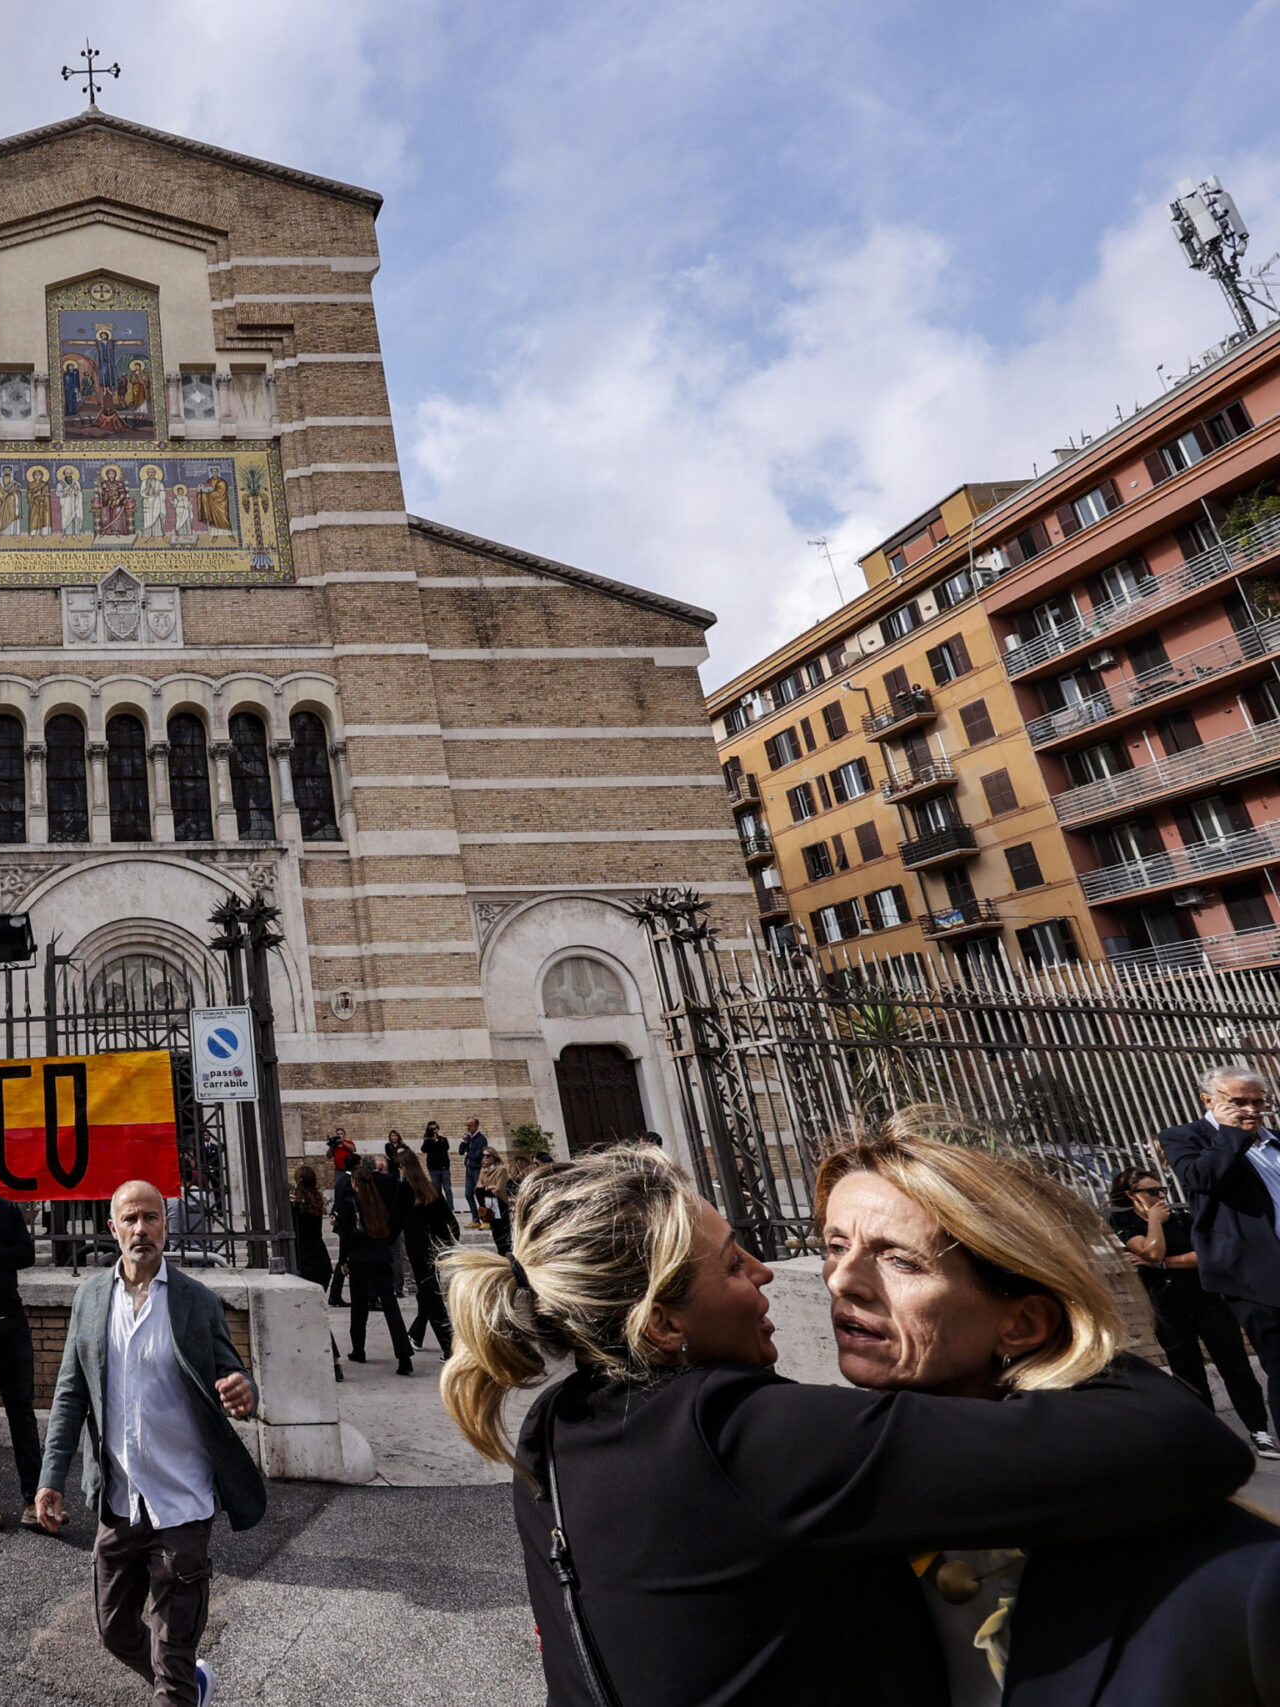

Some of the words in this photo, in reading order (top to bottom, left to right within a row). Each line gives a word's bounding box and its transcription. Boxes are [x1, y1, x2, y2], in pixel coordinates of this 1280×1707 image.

[190, 552, 229, 560] INFERNI
[210, 1070, 242, 1079] pass
[203, 1079, 249, 1088] carrabile
